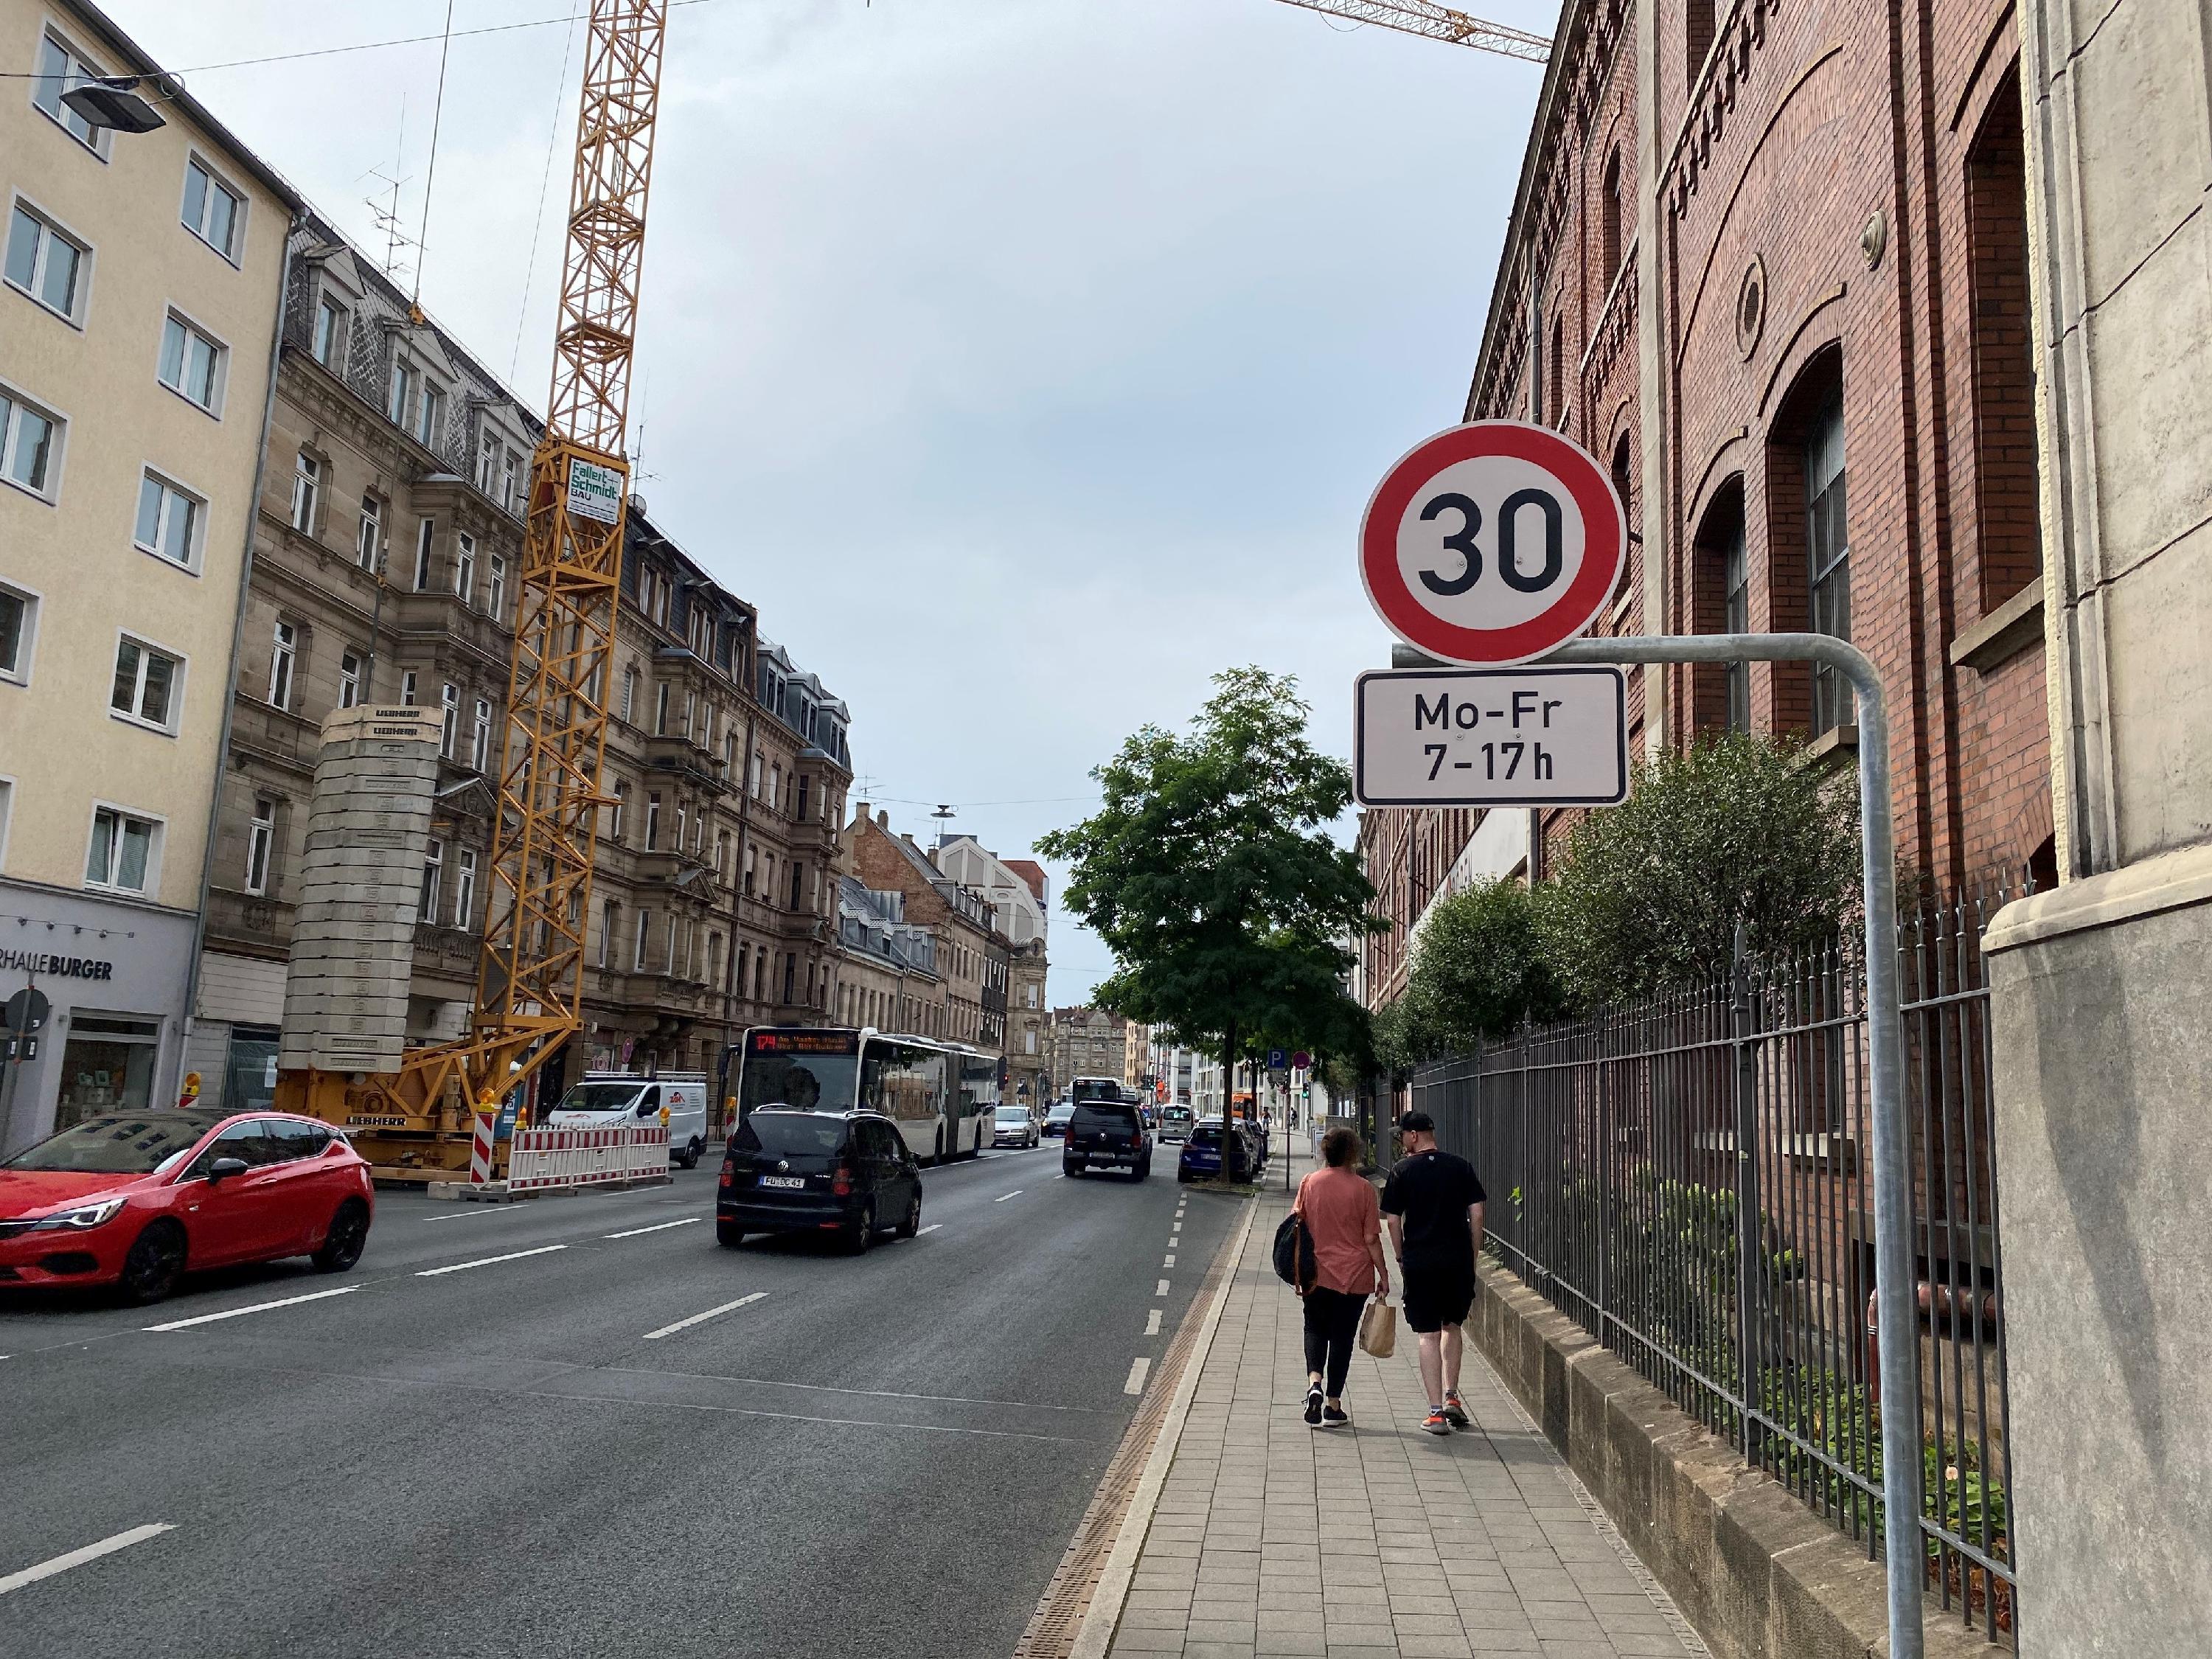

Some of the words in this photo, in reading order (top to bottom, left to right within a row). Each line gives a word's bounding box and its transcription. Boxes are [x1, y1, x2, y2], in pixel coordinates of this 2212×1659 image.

[573, 462, 608, 484] Fallert
[571, 475, 617, 500] Schmidt
[571, 488, 591, 501] BAU
[1418, 488, 1562, 596] 30
[375, 709, 420, 717] LIEBHERR
[1415, 691, 1562, 731] Mo-Fr
[373, 727, 417, 736] LIEBHERR
[1271, 1051, 1281, 1065] P
[345, 1116, 406, 1127] LIEBHERR
